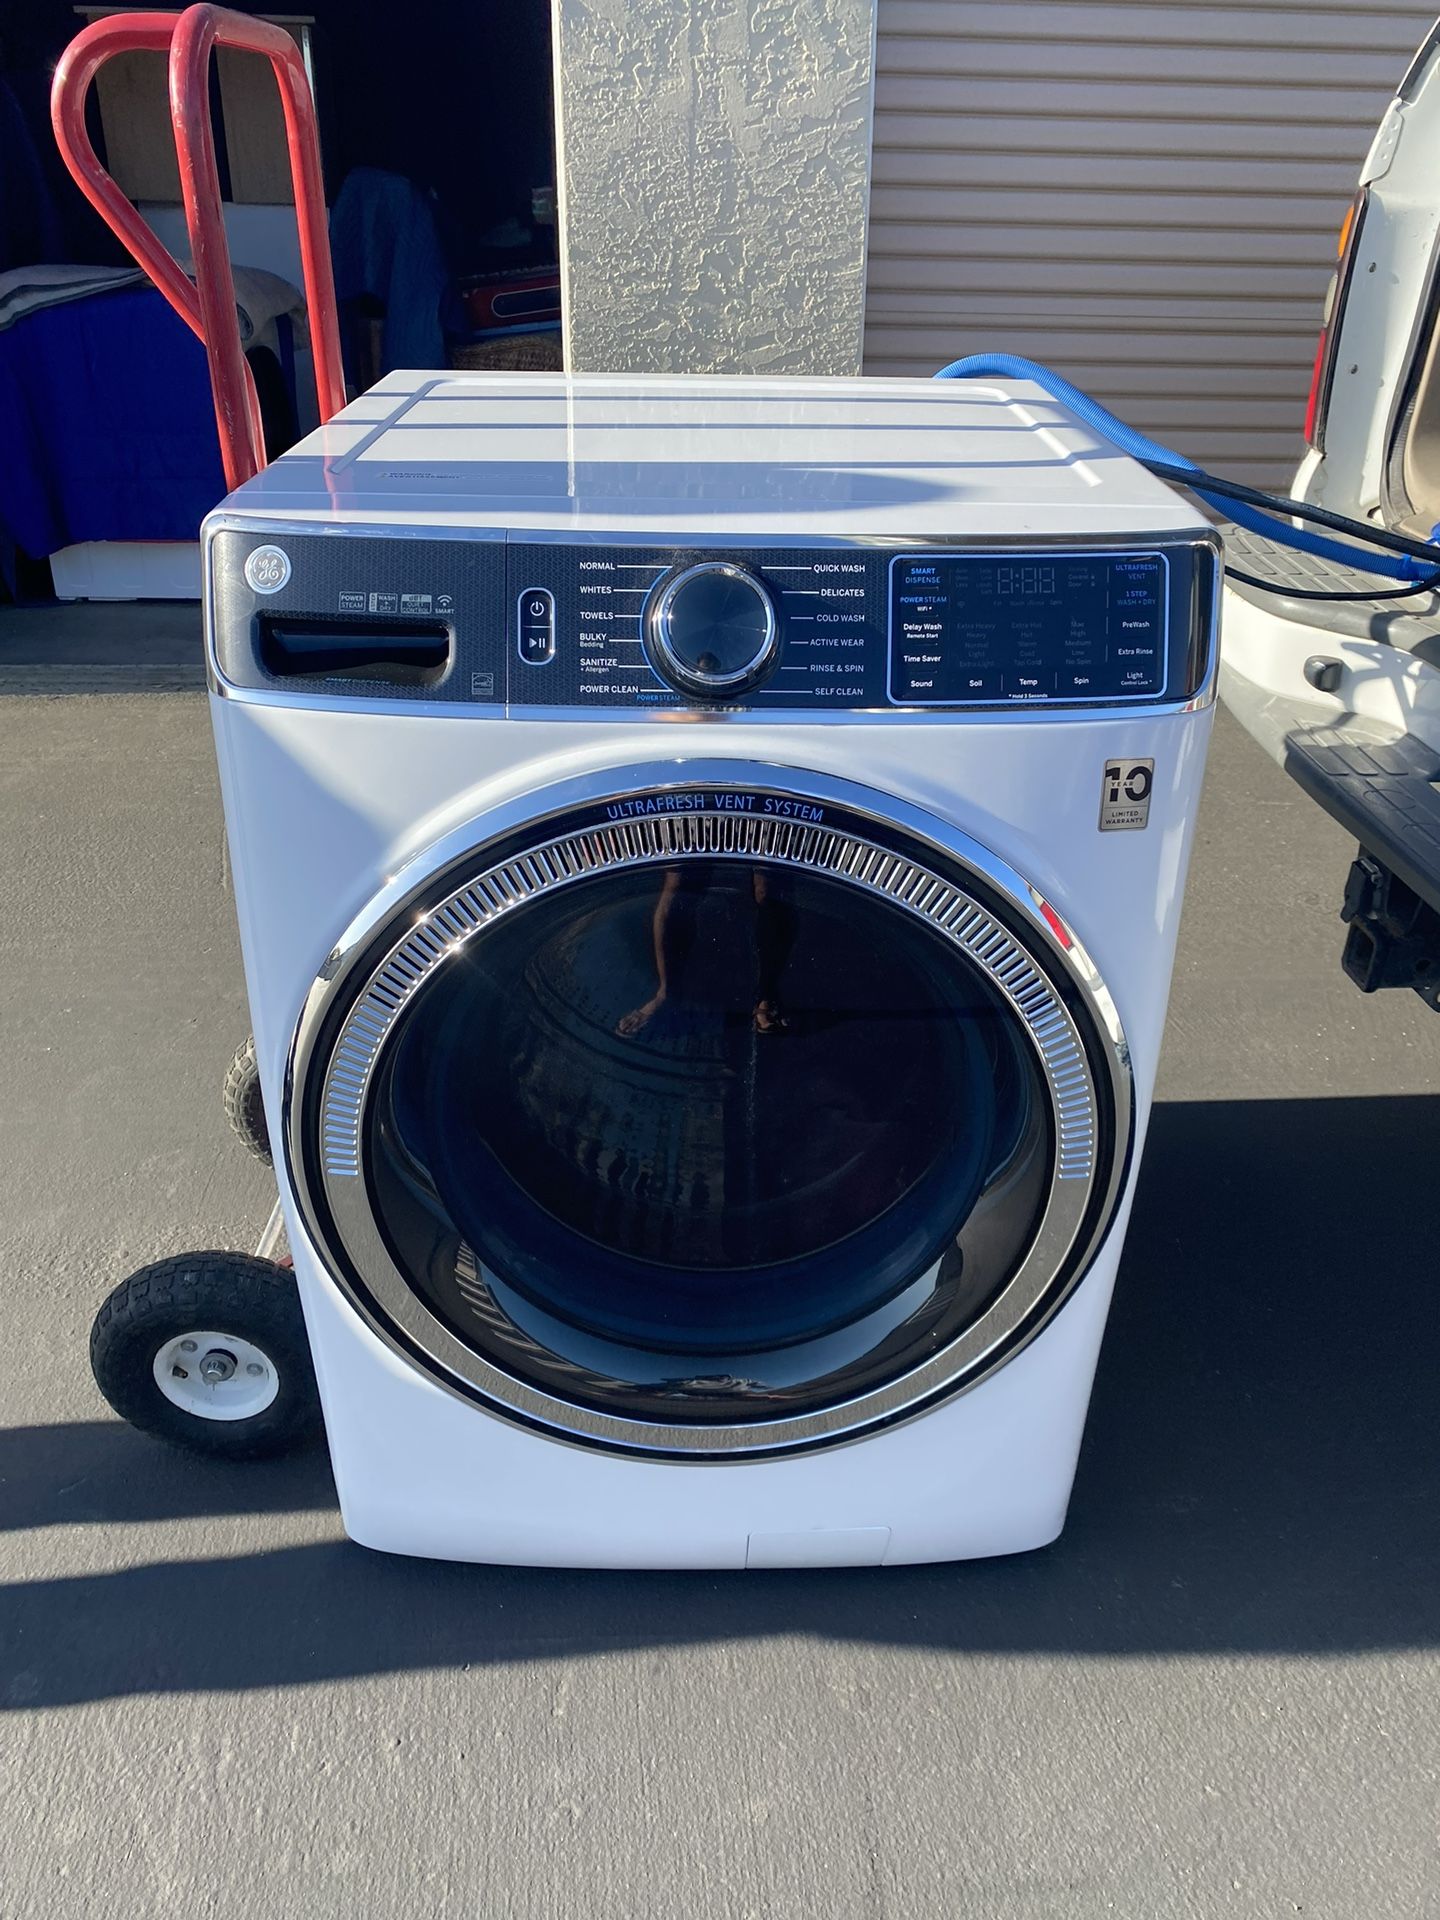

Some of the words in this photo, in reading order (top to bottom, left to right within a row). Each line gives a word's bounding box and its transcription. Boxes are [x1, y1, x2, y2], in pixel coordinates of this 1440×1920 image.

[580, 562, 615, 570] NORMAL
[814, 564, 840, 574] QUICK
[580, 612, 614, 620] TOWELS
[1105, 766, 1152, 802] 10
[606, 794, 705, 819] ULTRAFRESH
[714, 794, 755, 810] VENT
[764, 798, 824, 822] SYSTEM
